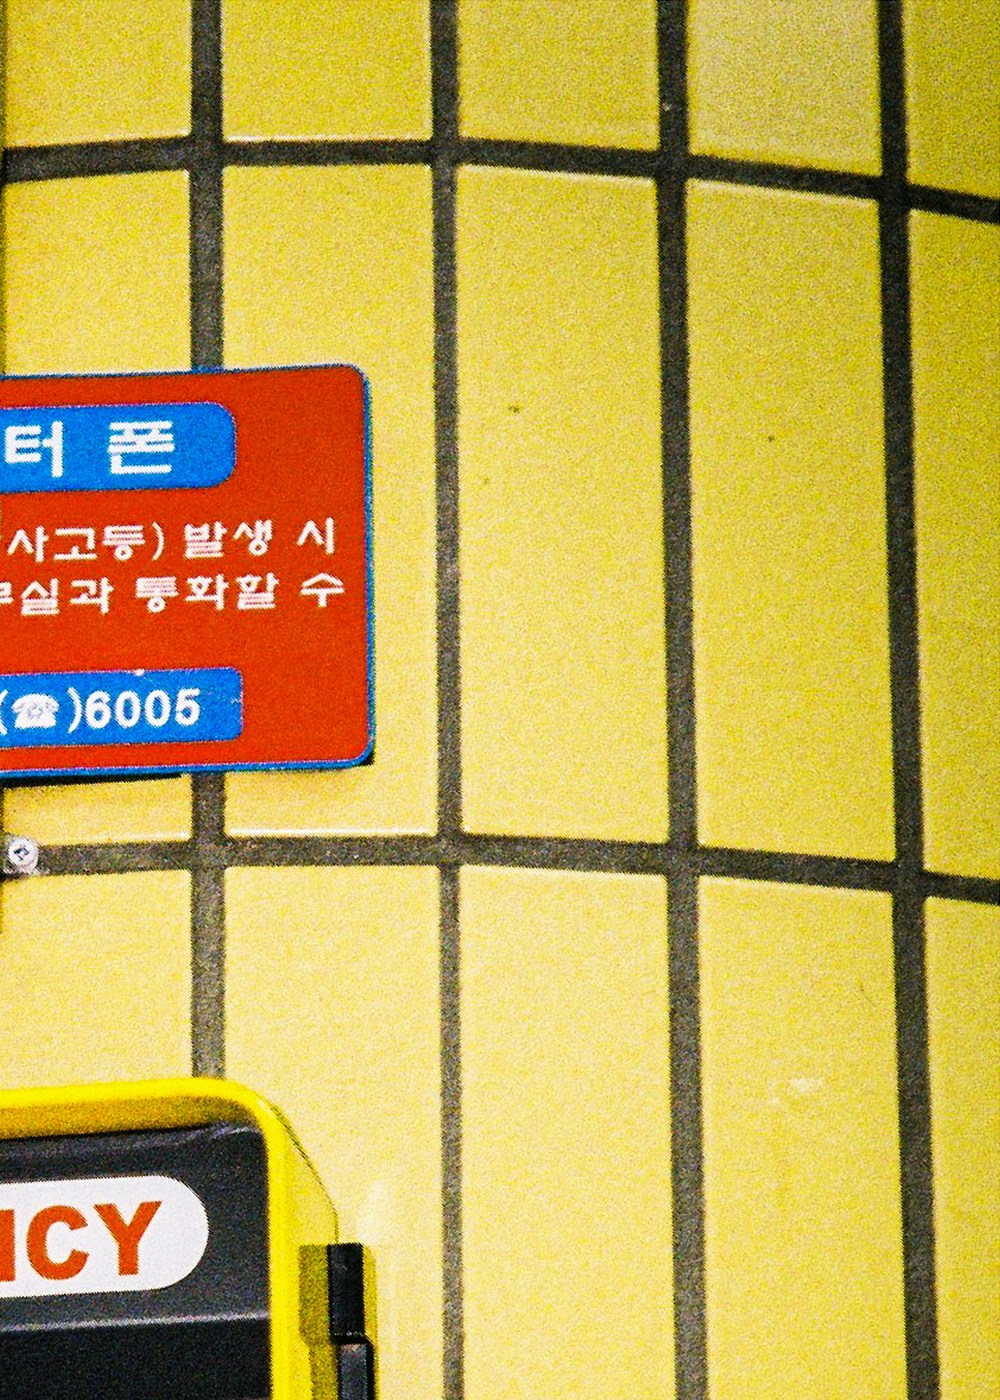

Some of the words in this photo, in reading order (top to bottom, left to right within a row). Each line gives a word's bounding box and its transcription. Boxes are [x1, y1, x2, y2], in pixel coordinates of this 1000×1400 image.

[184, 519, 274, 559] 발생
[296, 517, 336, 555] 시
[135, 572, 280, 614] 통화할
[299, 572, 346, 608] 수
